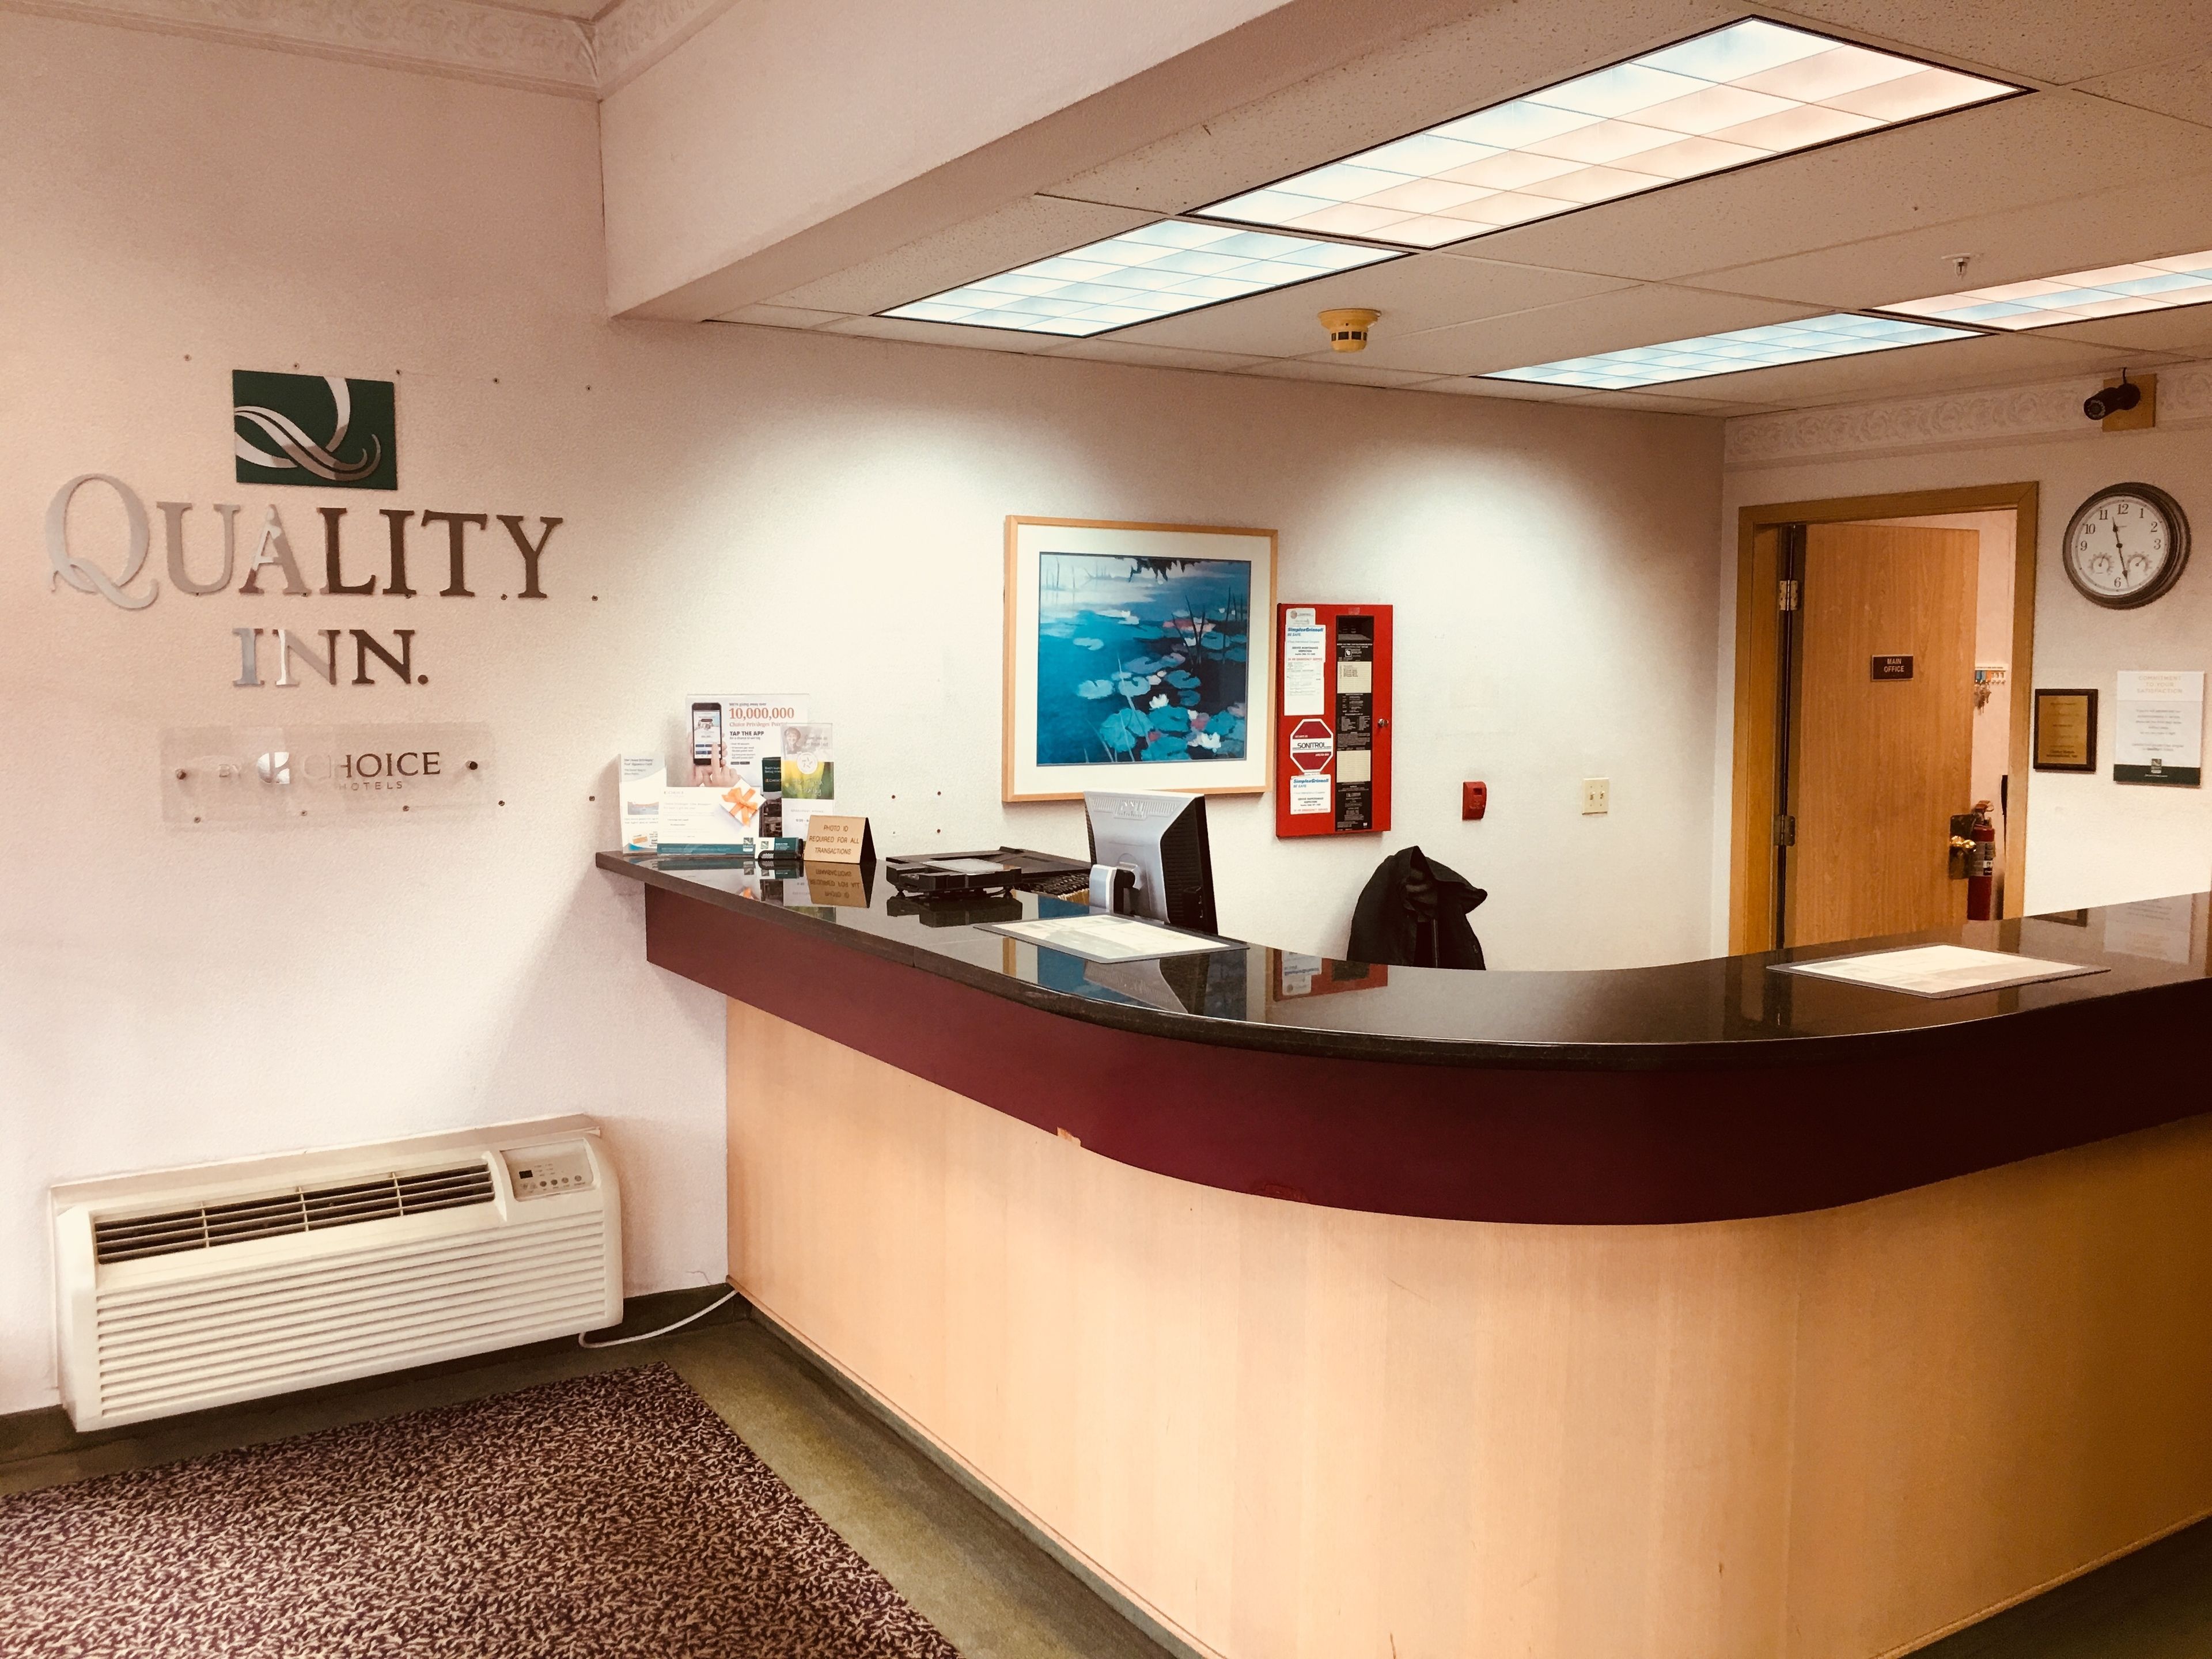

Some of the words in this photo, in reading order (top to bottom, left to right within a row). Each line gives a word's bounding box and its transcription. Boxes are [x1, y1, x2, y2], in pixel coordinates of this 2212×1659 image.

[2099, 509, 2108, 520] 11
[2117, 503, 2128, 515] 12
[2139, 508, 2144, 518] 1
[2085, 523, 2096, 534] 10
[2150, 521, 2158, 532] 2
[44, 473, 563, 610] QUALITY
[2080, 540, 2088, 551] 9
[2153, 539, 2161, 550] 3
[2114, 577, 2121, 588] 6
[729, 707, 794, 721] 10,000,000
[303, 751, 441, 779] CHOICE
[339, 780, 403, 790] HOTELS
